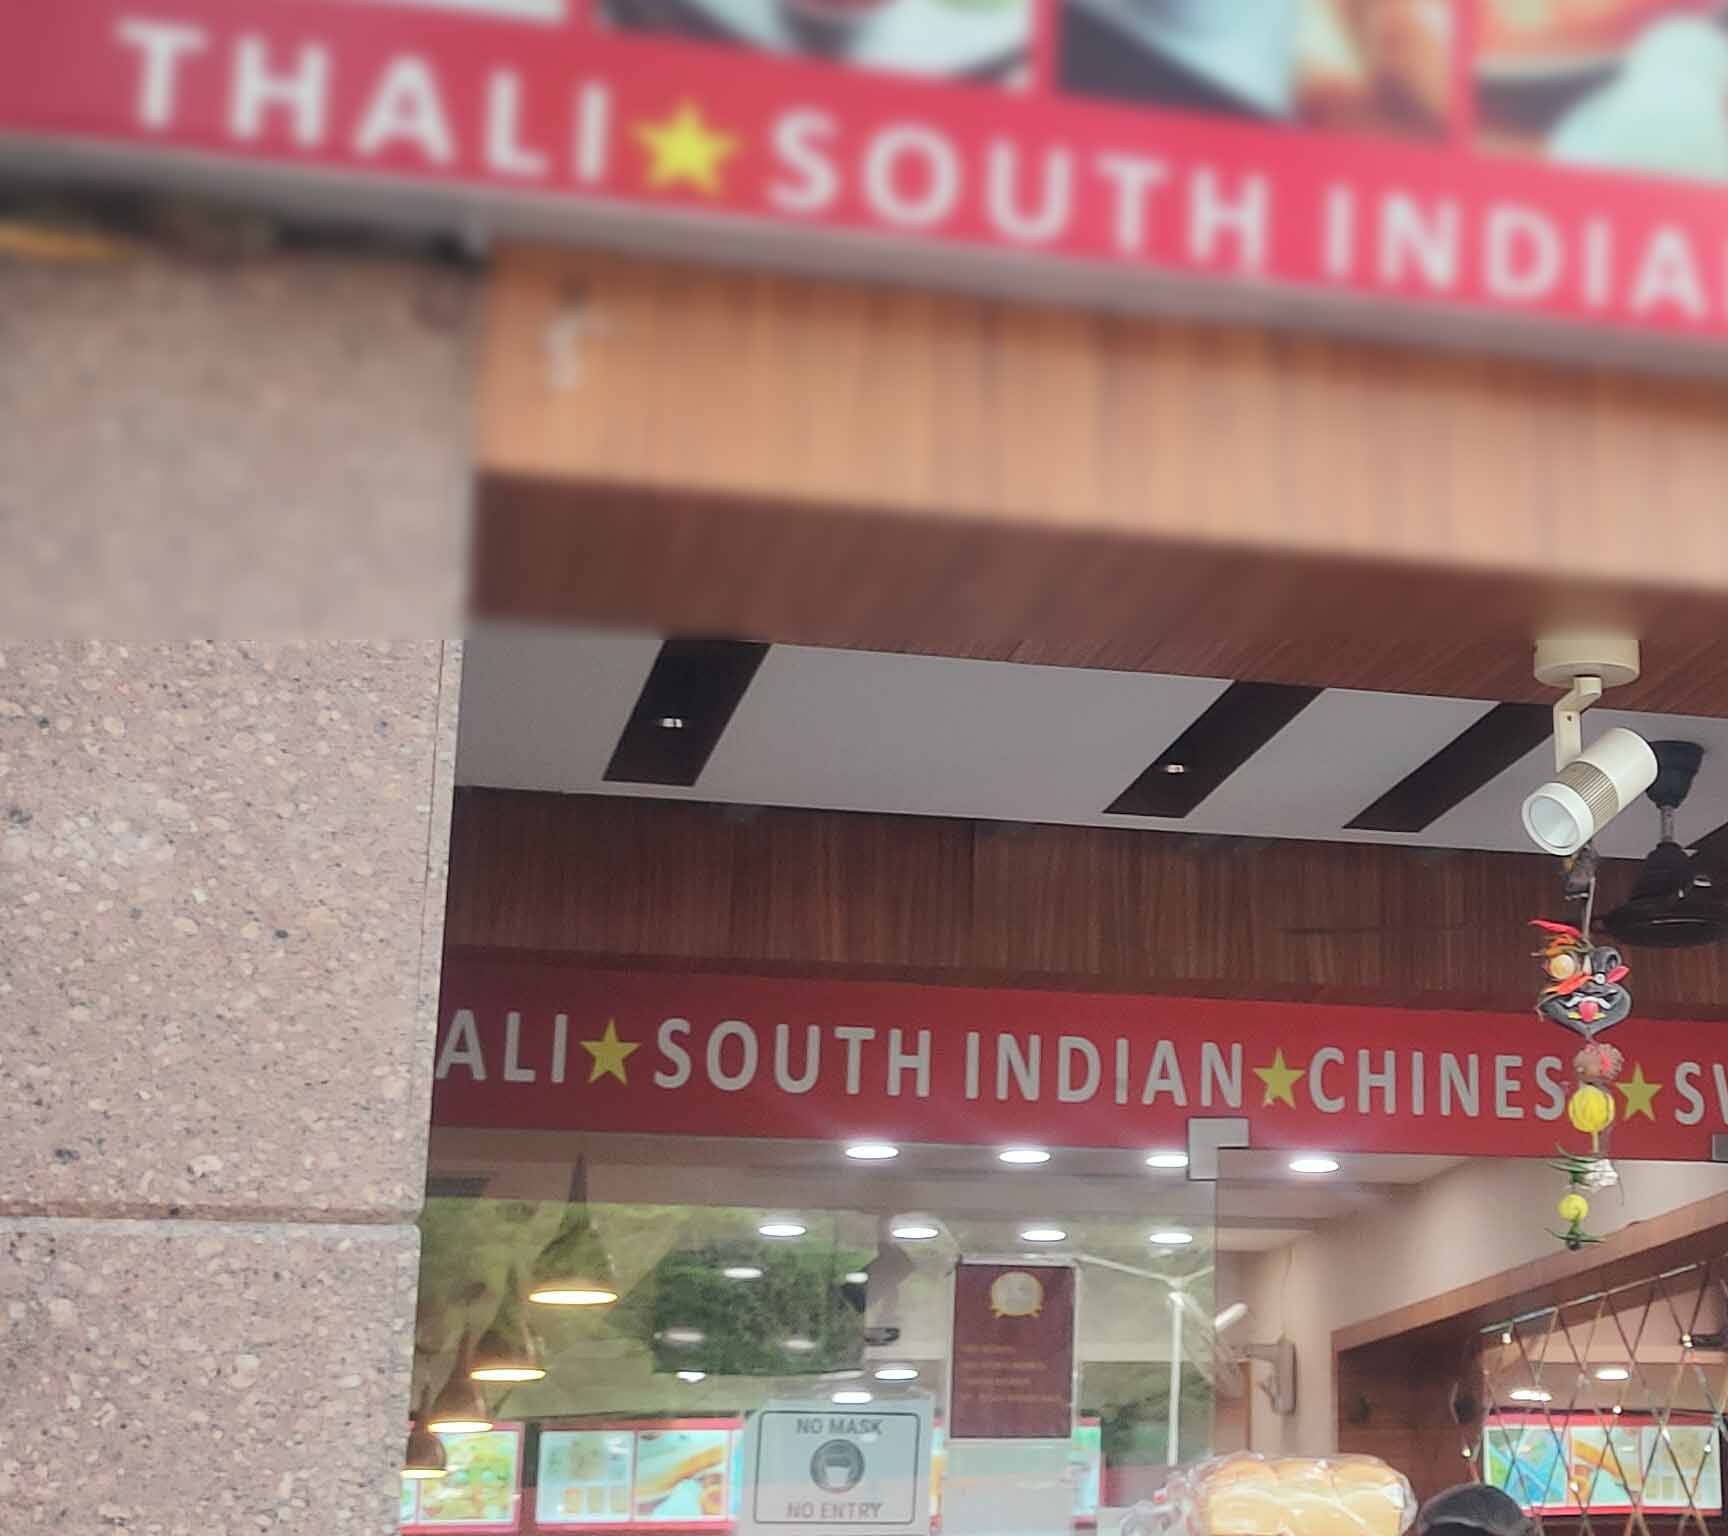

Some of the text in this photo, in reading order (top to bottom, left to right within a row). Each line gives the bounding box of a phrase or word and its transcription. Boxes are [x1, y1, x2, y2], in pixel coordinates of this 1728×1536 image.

[116, 19, 611, 188] THALI
[767, 108, 1268, 278] SOUTH
[437, 1009, 569, 1084] ALI
[653, 1018, 931, 1098] SOUTH
[966, 1031, 1244, 1109] INDIAN
[1308, 1046, 1568, 1120] CHINES
[797, 1418, 883, 1435] NO MASK
[787, 1502, 883, 1519] NO ENTRY
